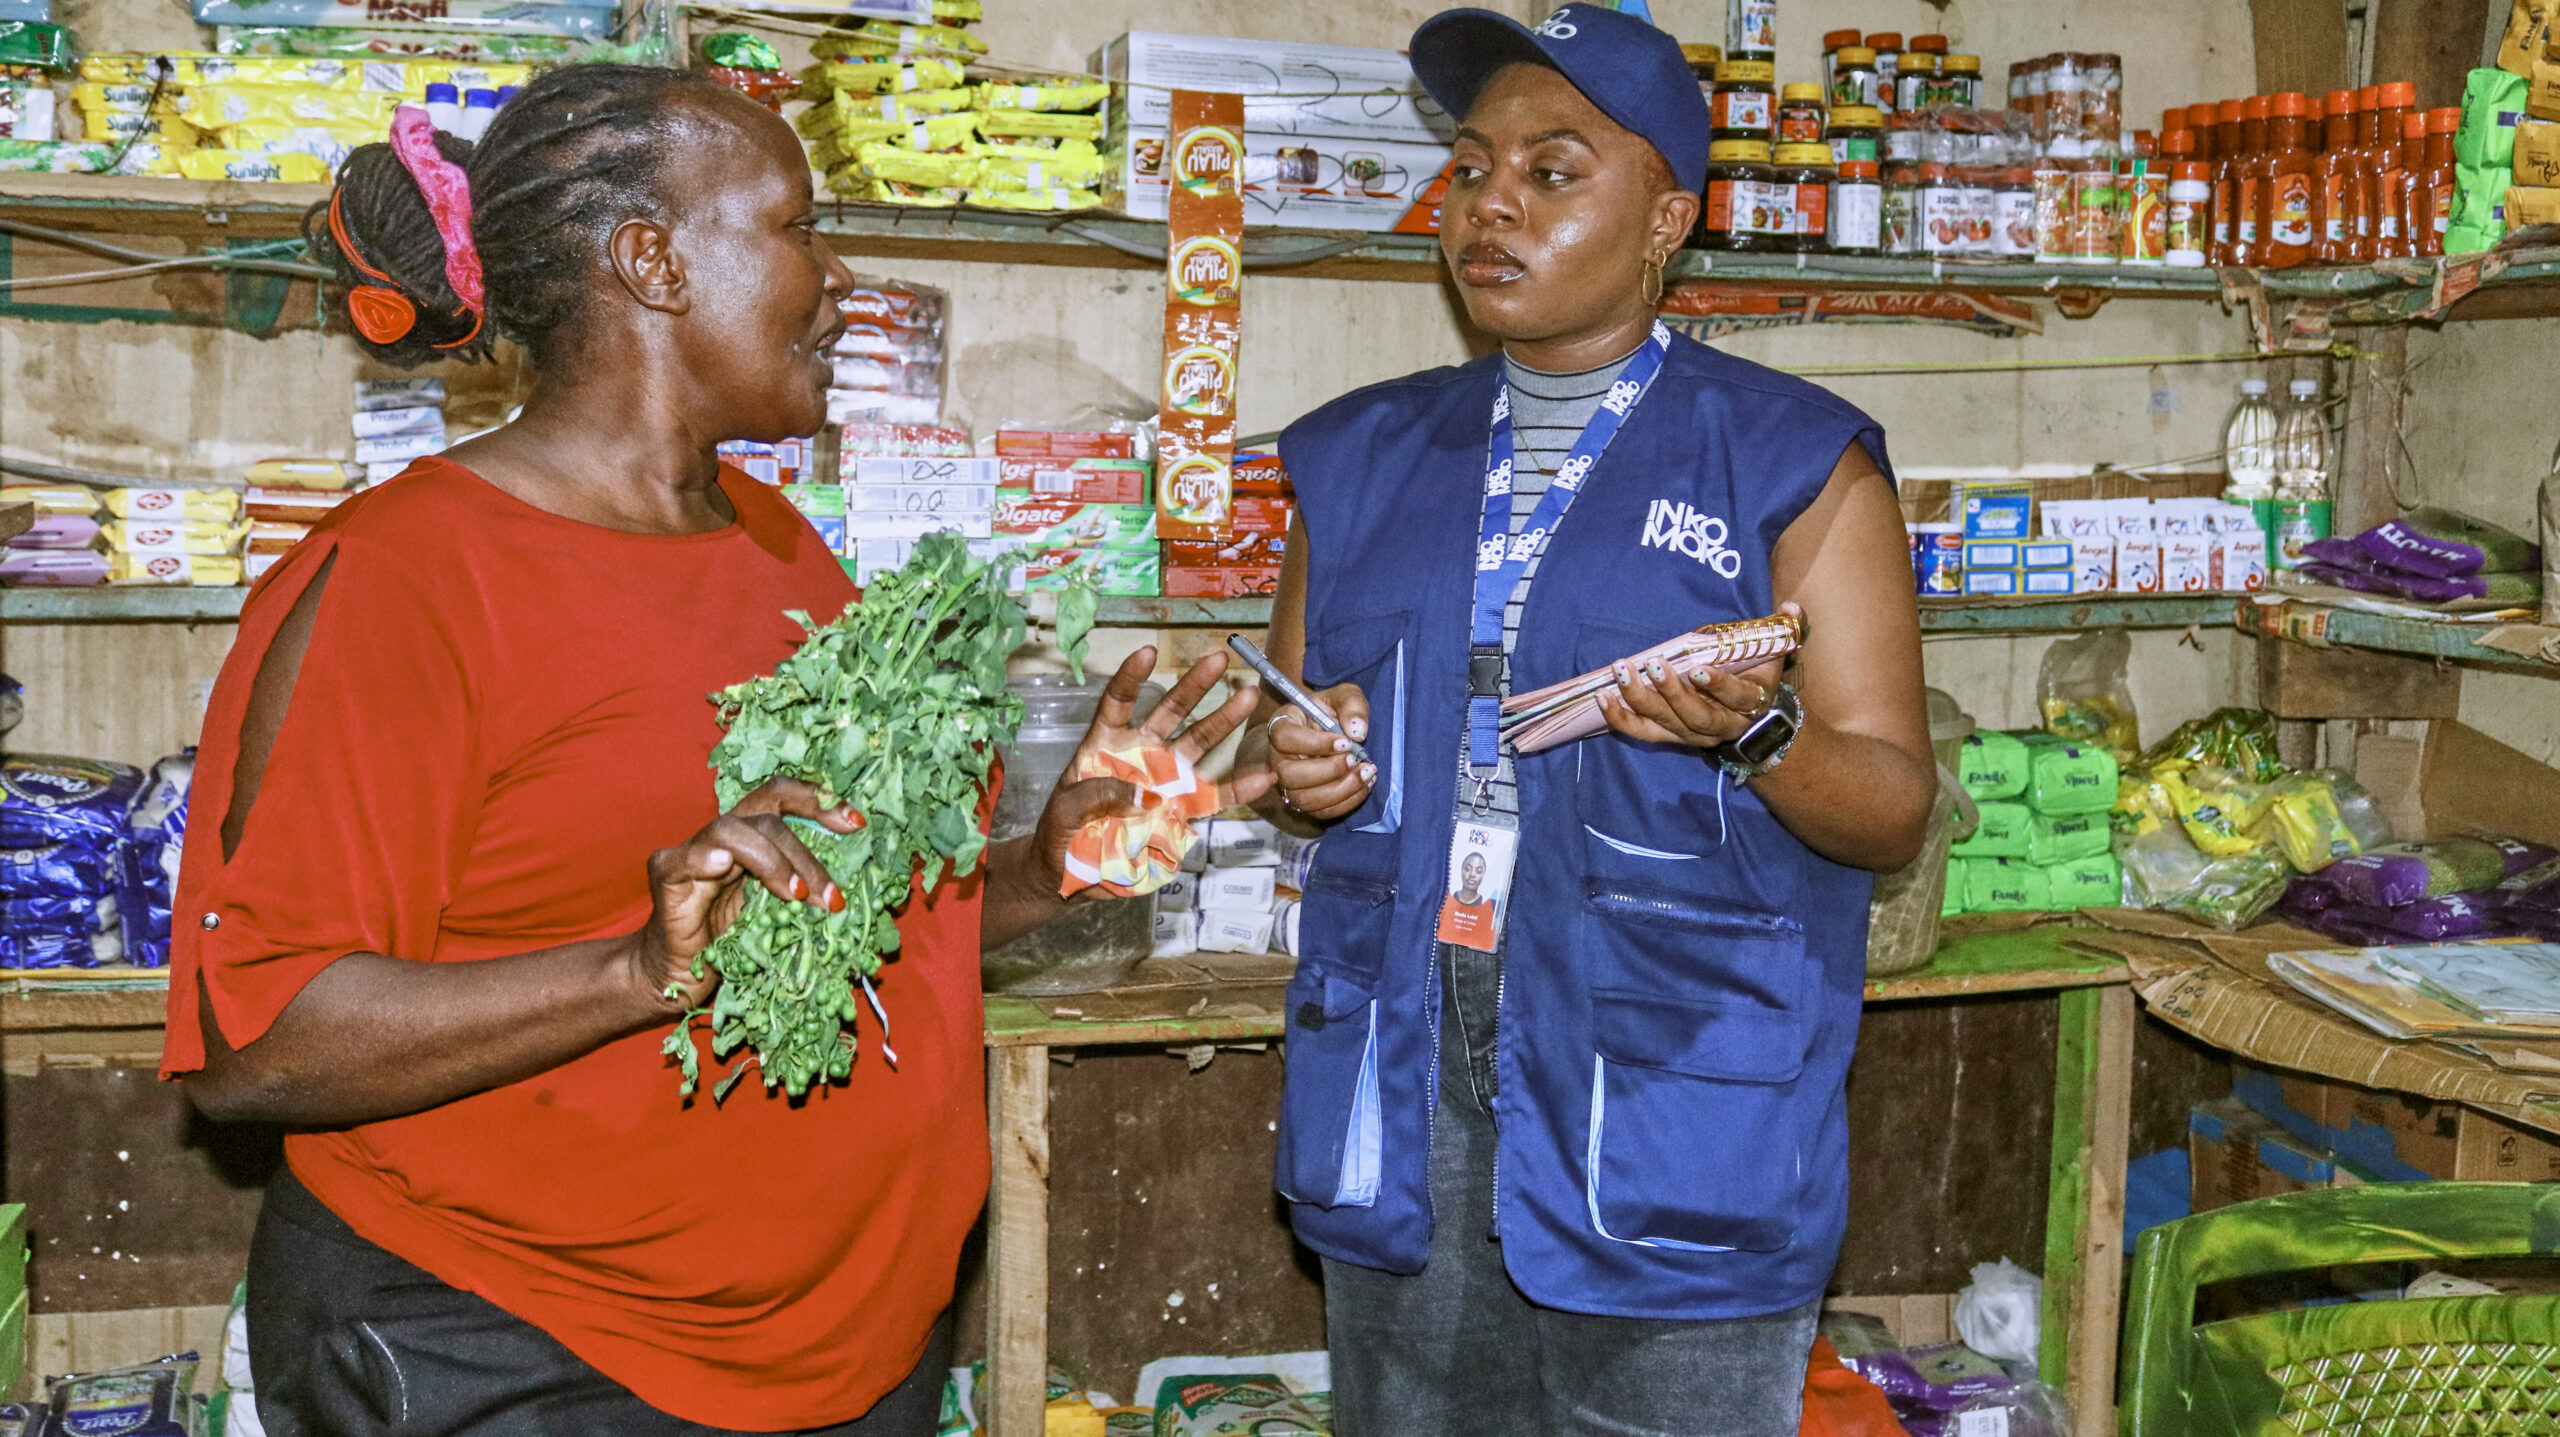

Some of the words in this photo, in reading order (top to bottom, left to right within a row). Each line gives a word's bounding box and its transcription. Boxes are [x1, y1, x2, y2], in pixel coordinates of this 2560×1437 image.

[225, 162, 282, 182] Sunlight
[1186, 152, 1231, 173] PILAU
[1184, 261, 1228, 282] PILAU
[371, 380, 412, 391] Protex
[1601, 380, 1627, 408] INKO
[1613, 380, 1640, 417] MOKO
[370, 410, 409, 422] Protex
[373, 439, 413, 451] Protex
[1552, 458, 1578, 487] INKO
[1563, 454, 1593, 491] MOKO
[993, 504, 1064, 527] olgate
[1647, 499, 1729, 547] INKO
[1517, 528, 1546, 562] MOKO
[1641, 519, 1742, 579] MOKO
[2080, 544, 2109, 556] Angel
[2126, 541, 2152, 553] Angel
[2234, 541, 2261, 552] Angel
[14, 772, 92, 793] Pearl
[1468, 836, 1494, 847] MOKO
[1470, 828, 1490, 838] INKO
